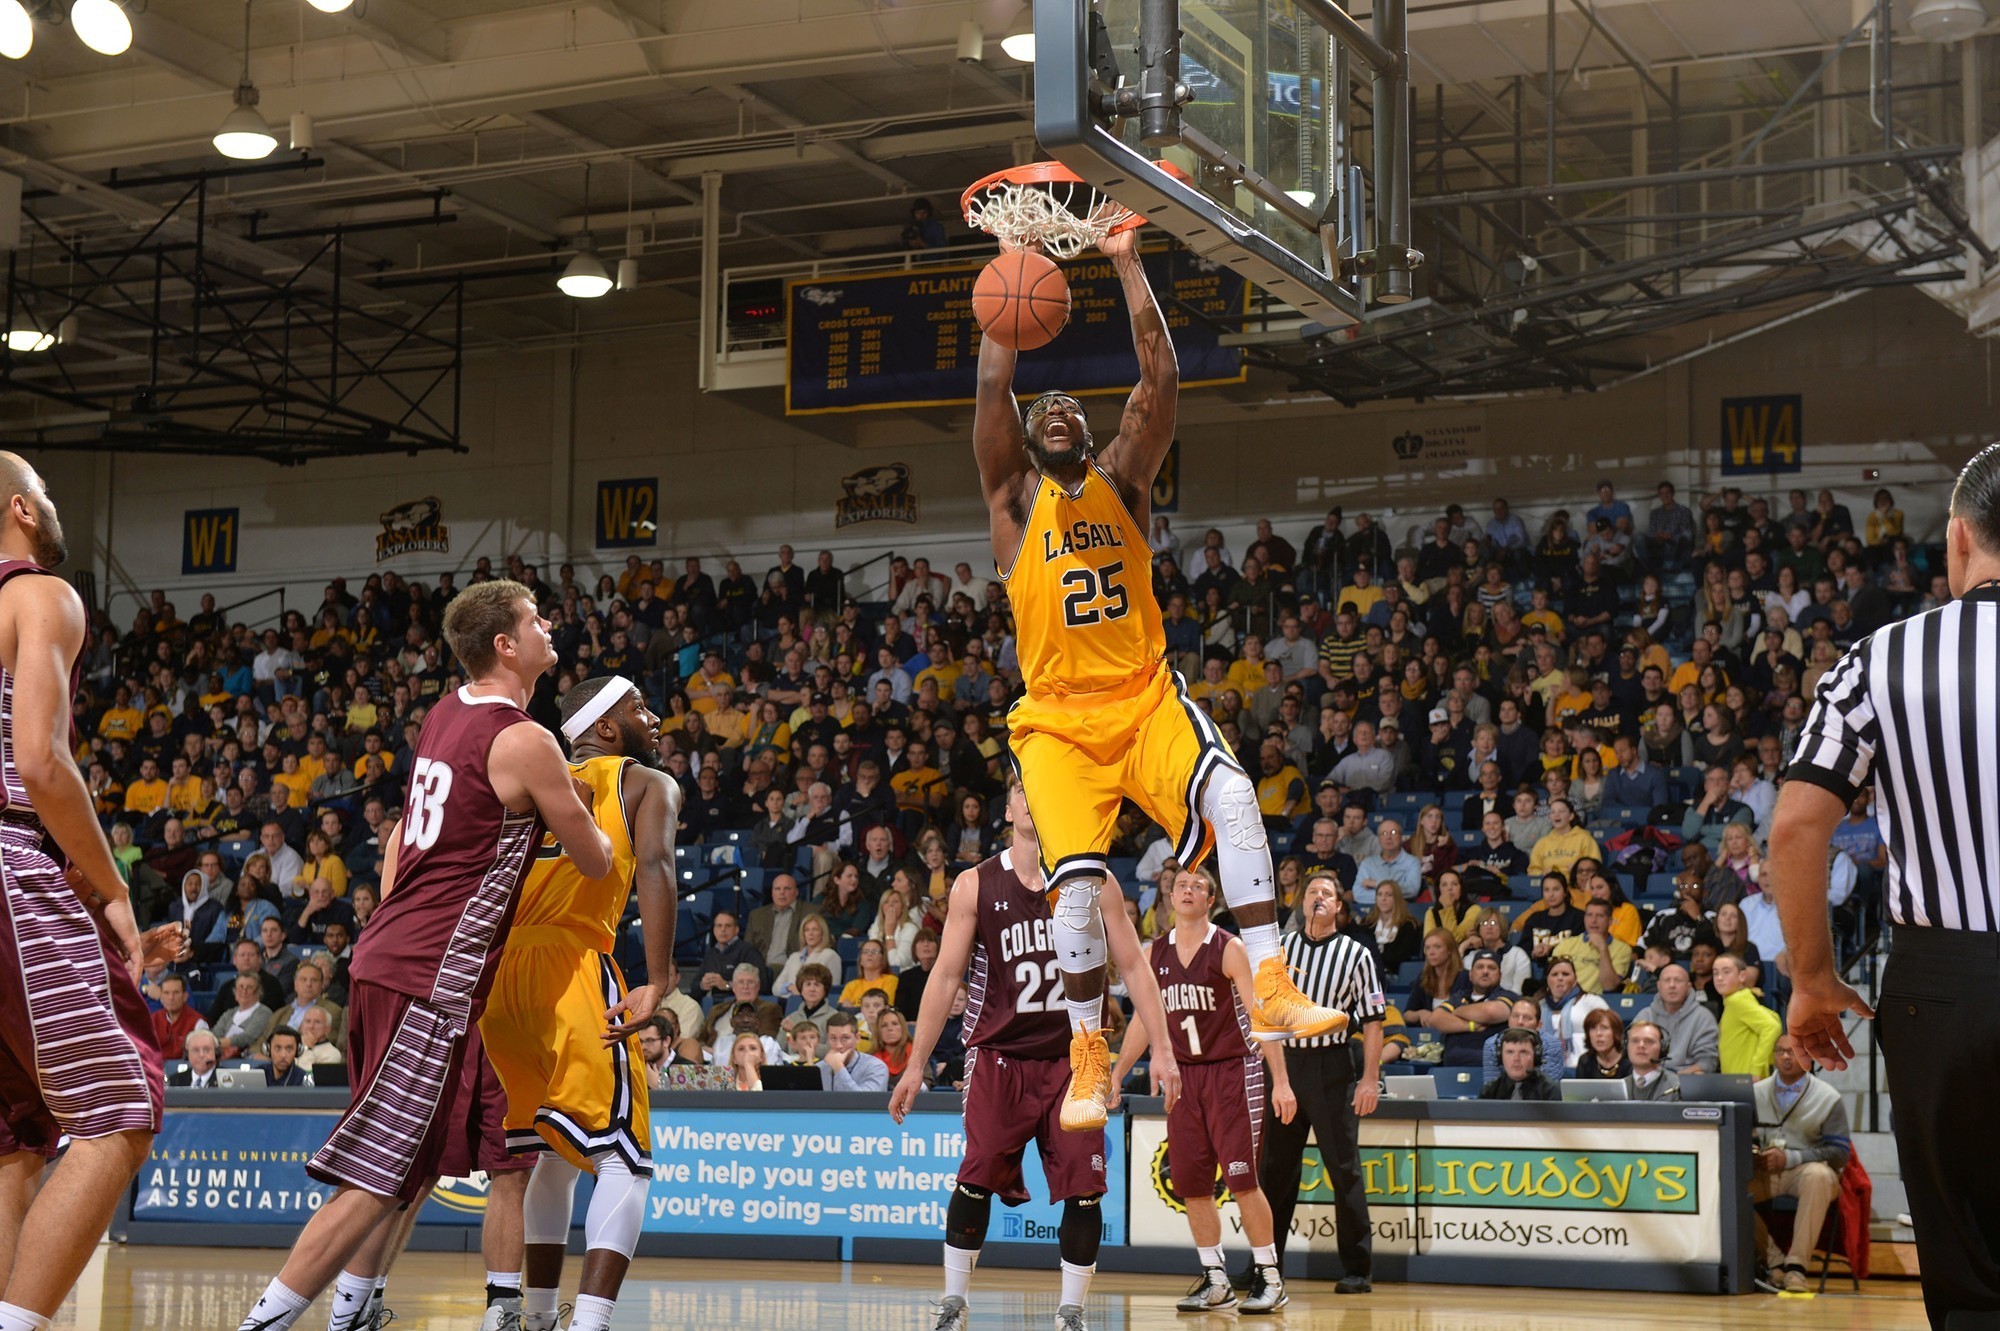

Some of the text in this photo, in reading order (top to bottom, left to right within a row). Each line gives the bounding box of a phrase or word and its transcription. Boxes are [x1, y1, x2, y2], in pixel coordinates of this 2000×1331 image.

[818, 315, 894, 330] CROSS COUNTRY
[1727, 404, 1796, 465] W4
[602, 486, 655, 539] W2
[190, 515, 233, 567] W1
[1061, 560, 1129, 628] 25
[403, 757, 453, 850] 53
[1000, 918, 1056, 962] COLGA
[1015, 958, 1068, 1013] 22
[1161, 983, 1217, 1014] COLGATE
[1180, 1015, 1202, 1055] 1
[151, 1149, 308, 1163] LA SALLE UNIVERS
[654, 1125, 784, 1153] Wherever
[792, 1134, 841, 1157] you
[849, 1136, 893, 1156] are
[901, 1132, 926, 1157] in
[150, 1168, 261, 1188] ALUMNI
[653, 1159, 957, 1192] we help you get where
[147, 1188, 323, 1211] ASSOCIATIO
[651, 1193, 735, 1220] you're
